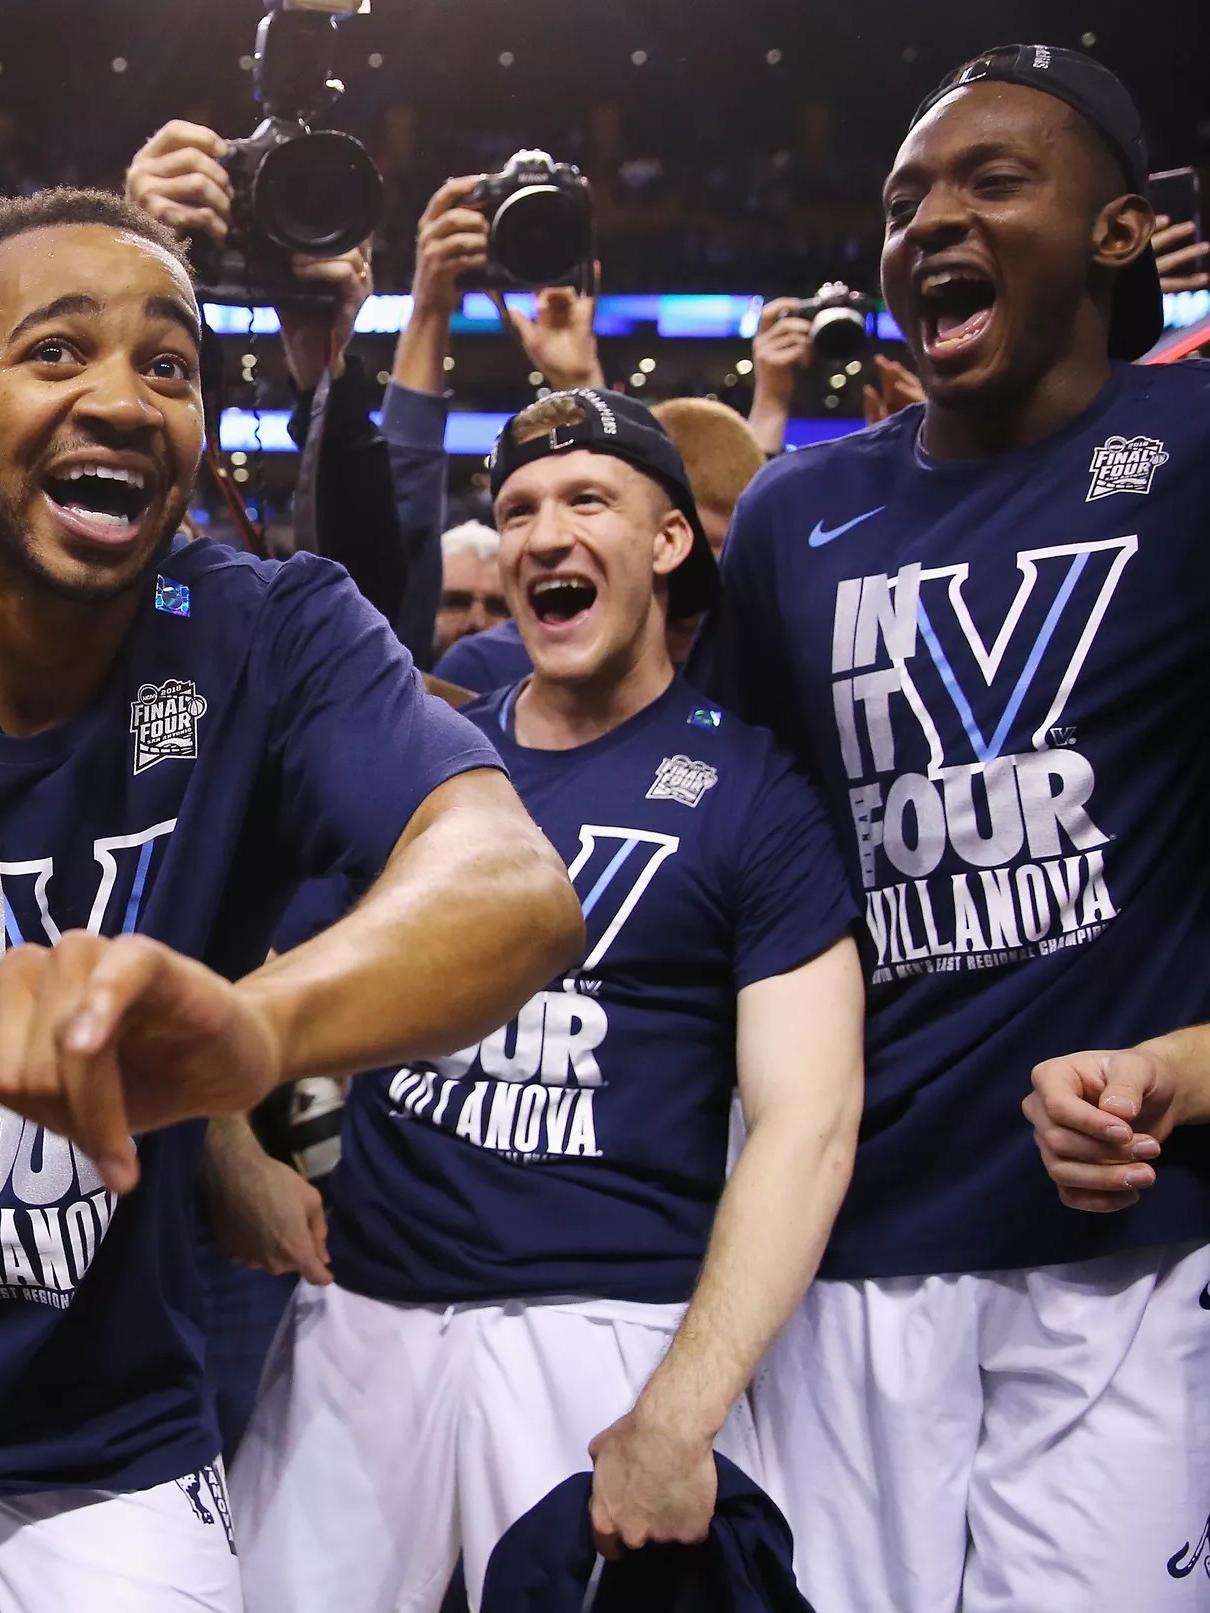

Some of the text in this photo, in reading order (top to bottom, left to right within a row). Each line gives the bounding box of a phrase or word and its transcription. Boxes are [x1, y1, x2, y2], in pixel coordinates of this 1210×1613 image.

[1095, 449, 1150, 468] FINAL
[1099, 462, 1151, 480] FOUR
[832, 562, 922, 674] IN
[160, 684, 182, 696] 2018
[134, 696, 187, 727] FINAL
[832, 666, 902, 780] IT
[140, 712, 191, 743] FOUR
[849, 749, 1111, 888] FOUR
[865, 850, 1119, 967] VILLANOVA
